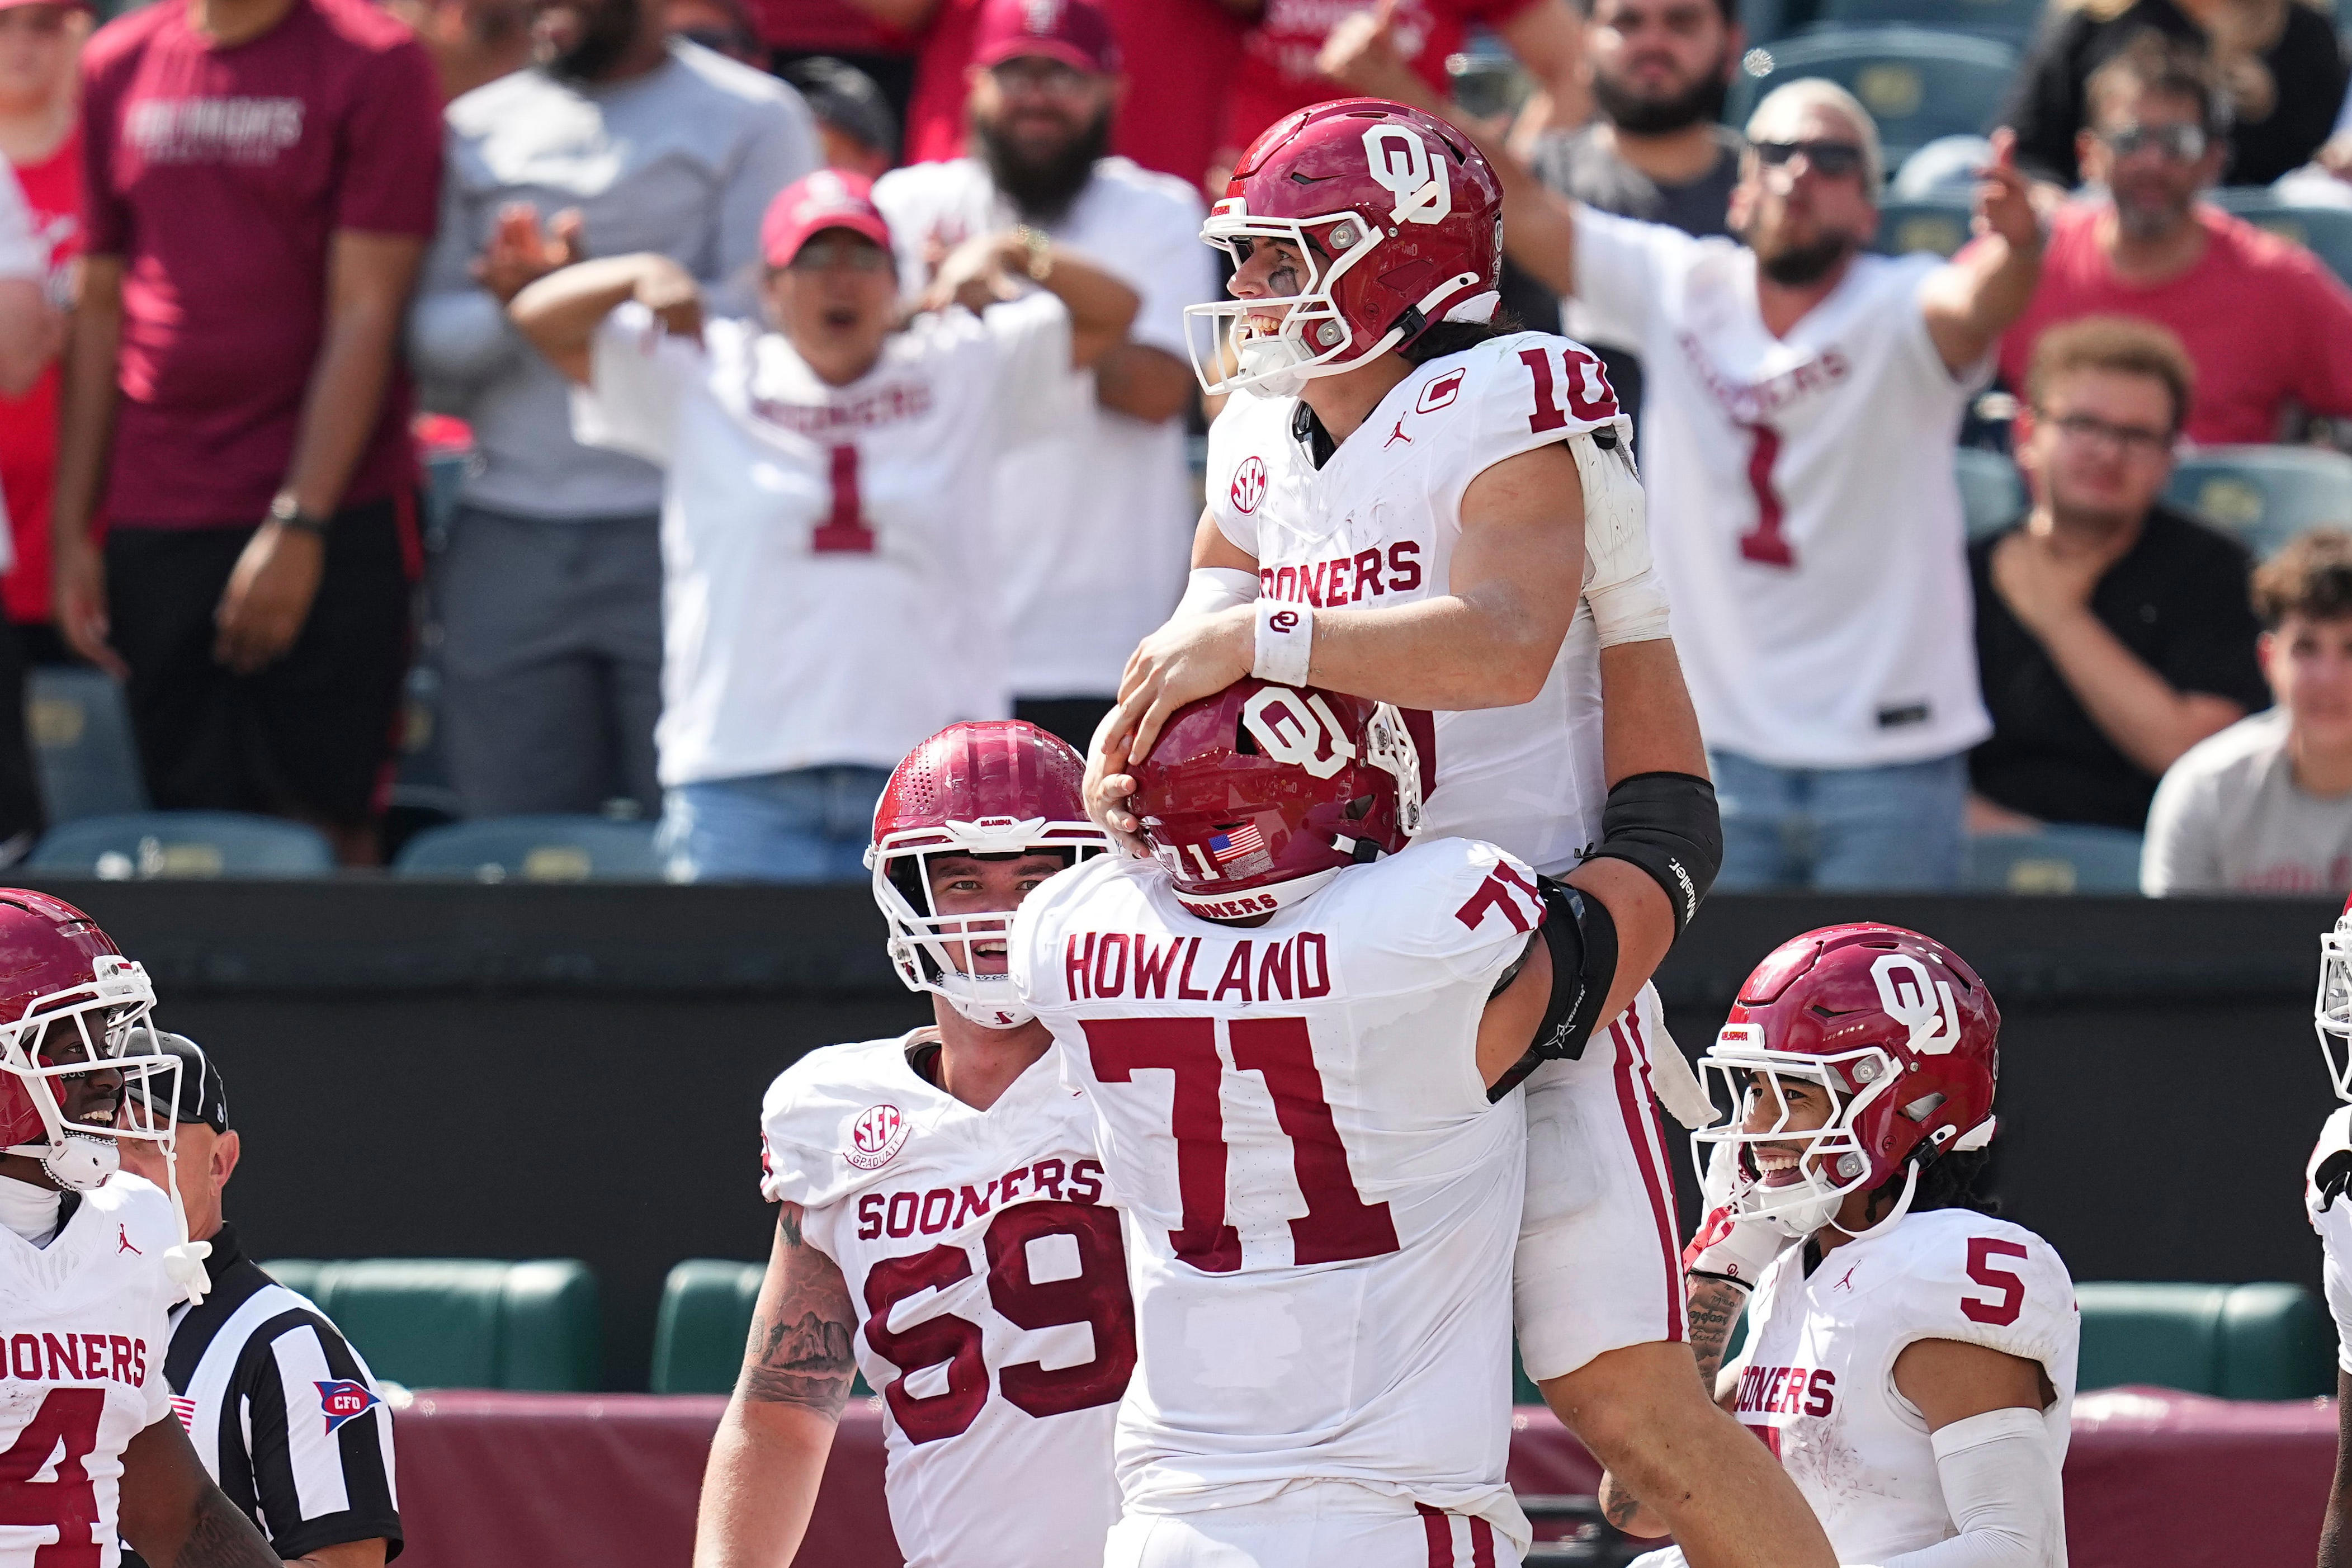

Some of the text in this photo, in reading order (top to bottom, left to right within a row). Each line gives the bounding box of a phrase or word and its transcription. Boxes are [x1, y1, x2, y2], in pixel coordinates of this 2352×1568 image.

[1361, 124, 1452, 225] OU
[1518, 347, 1618, 434] 10
[813, 444, 875, 552] 1
[1231, 456, 1265, 513] SEC
[1735, 421, 1796, 569] 1
[1259, 540, 1421, 609] OONERS
[1243, 686, 1350, 780] OU
[1156, 843, 1221, 881] 71
[1455, 858, 1548, 934] 71
[1066, 932, 1331, 1002] HOWLAND
[1869, 953, 1962, 1056] OU
[852, 1137, 902, 1168] GRADUATE
[854, 1106, 900, 1152] SEC
[1077, 1017, 1401, 1273] 71
[858, 1158, 1105, 1241] SOONERS
[863, 1199, 1139, 1446] 69
[1960, 1237, 2028, 1327] 5
[334, 1396, 361, 1410] CFO
[1734, 1366, 1836, 1418] OONERS
[0, 1388, 106, 1568] 4
